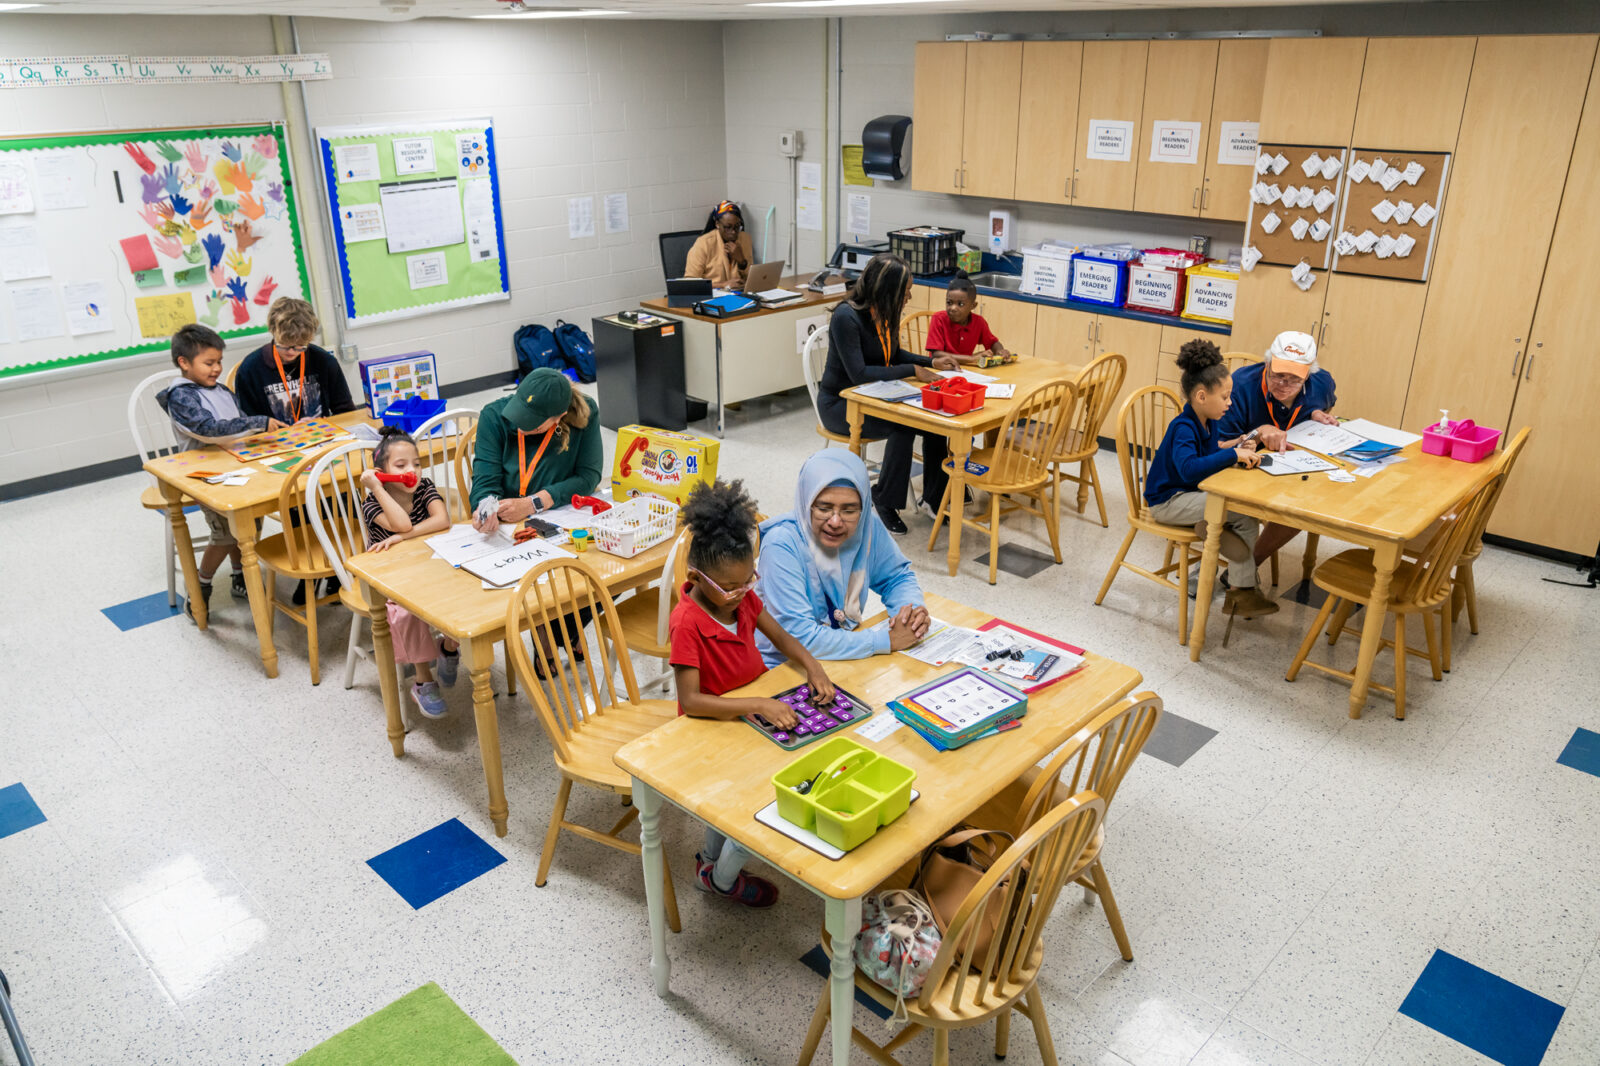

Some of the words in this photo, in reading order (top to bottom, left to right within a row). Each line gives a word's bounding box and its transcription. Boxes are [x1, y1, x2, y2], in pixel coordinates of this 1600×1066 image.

[19, 66, 44, 82] Qq
[55, 66, 68, 77] Rr
[84, 64, 99, 76] Ss
[111, 63, 124, 75] Tt
[138, 65, 156, 78] Uu
[176, 64, 192, 76] Vv
[210, 64, 233, 75] Ww
[244, 64, 260, 76] Xx
[280, 63, 295, 78] Yy
[313, 61, 327, 73] Zz
[1161, 136, 1190, 144] BEGINNING
[1080, 272, 1111, 282] EMERGING
[1081, 280, 1108, 290] READERS
[1135, 279, 1172, 290] BEGINNING
[1138, 288, 1167, 298] READERS
[1195, 288, 1232, 299] ADVANCING
[1197, 297, 1227, 307] READERS
[686, 455, 698, 467] 10
